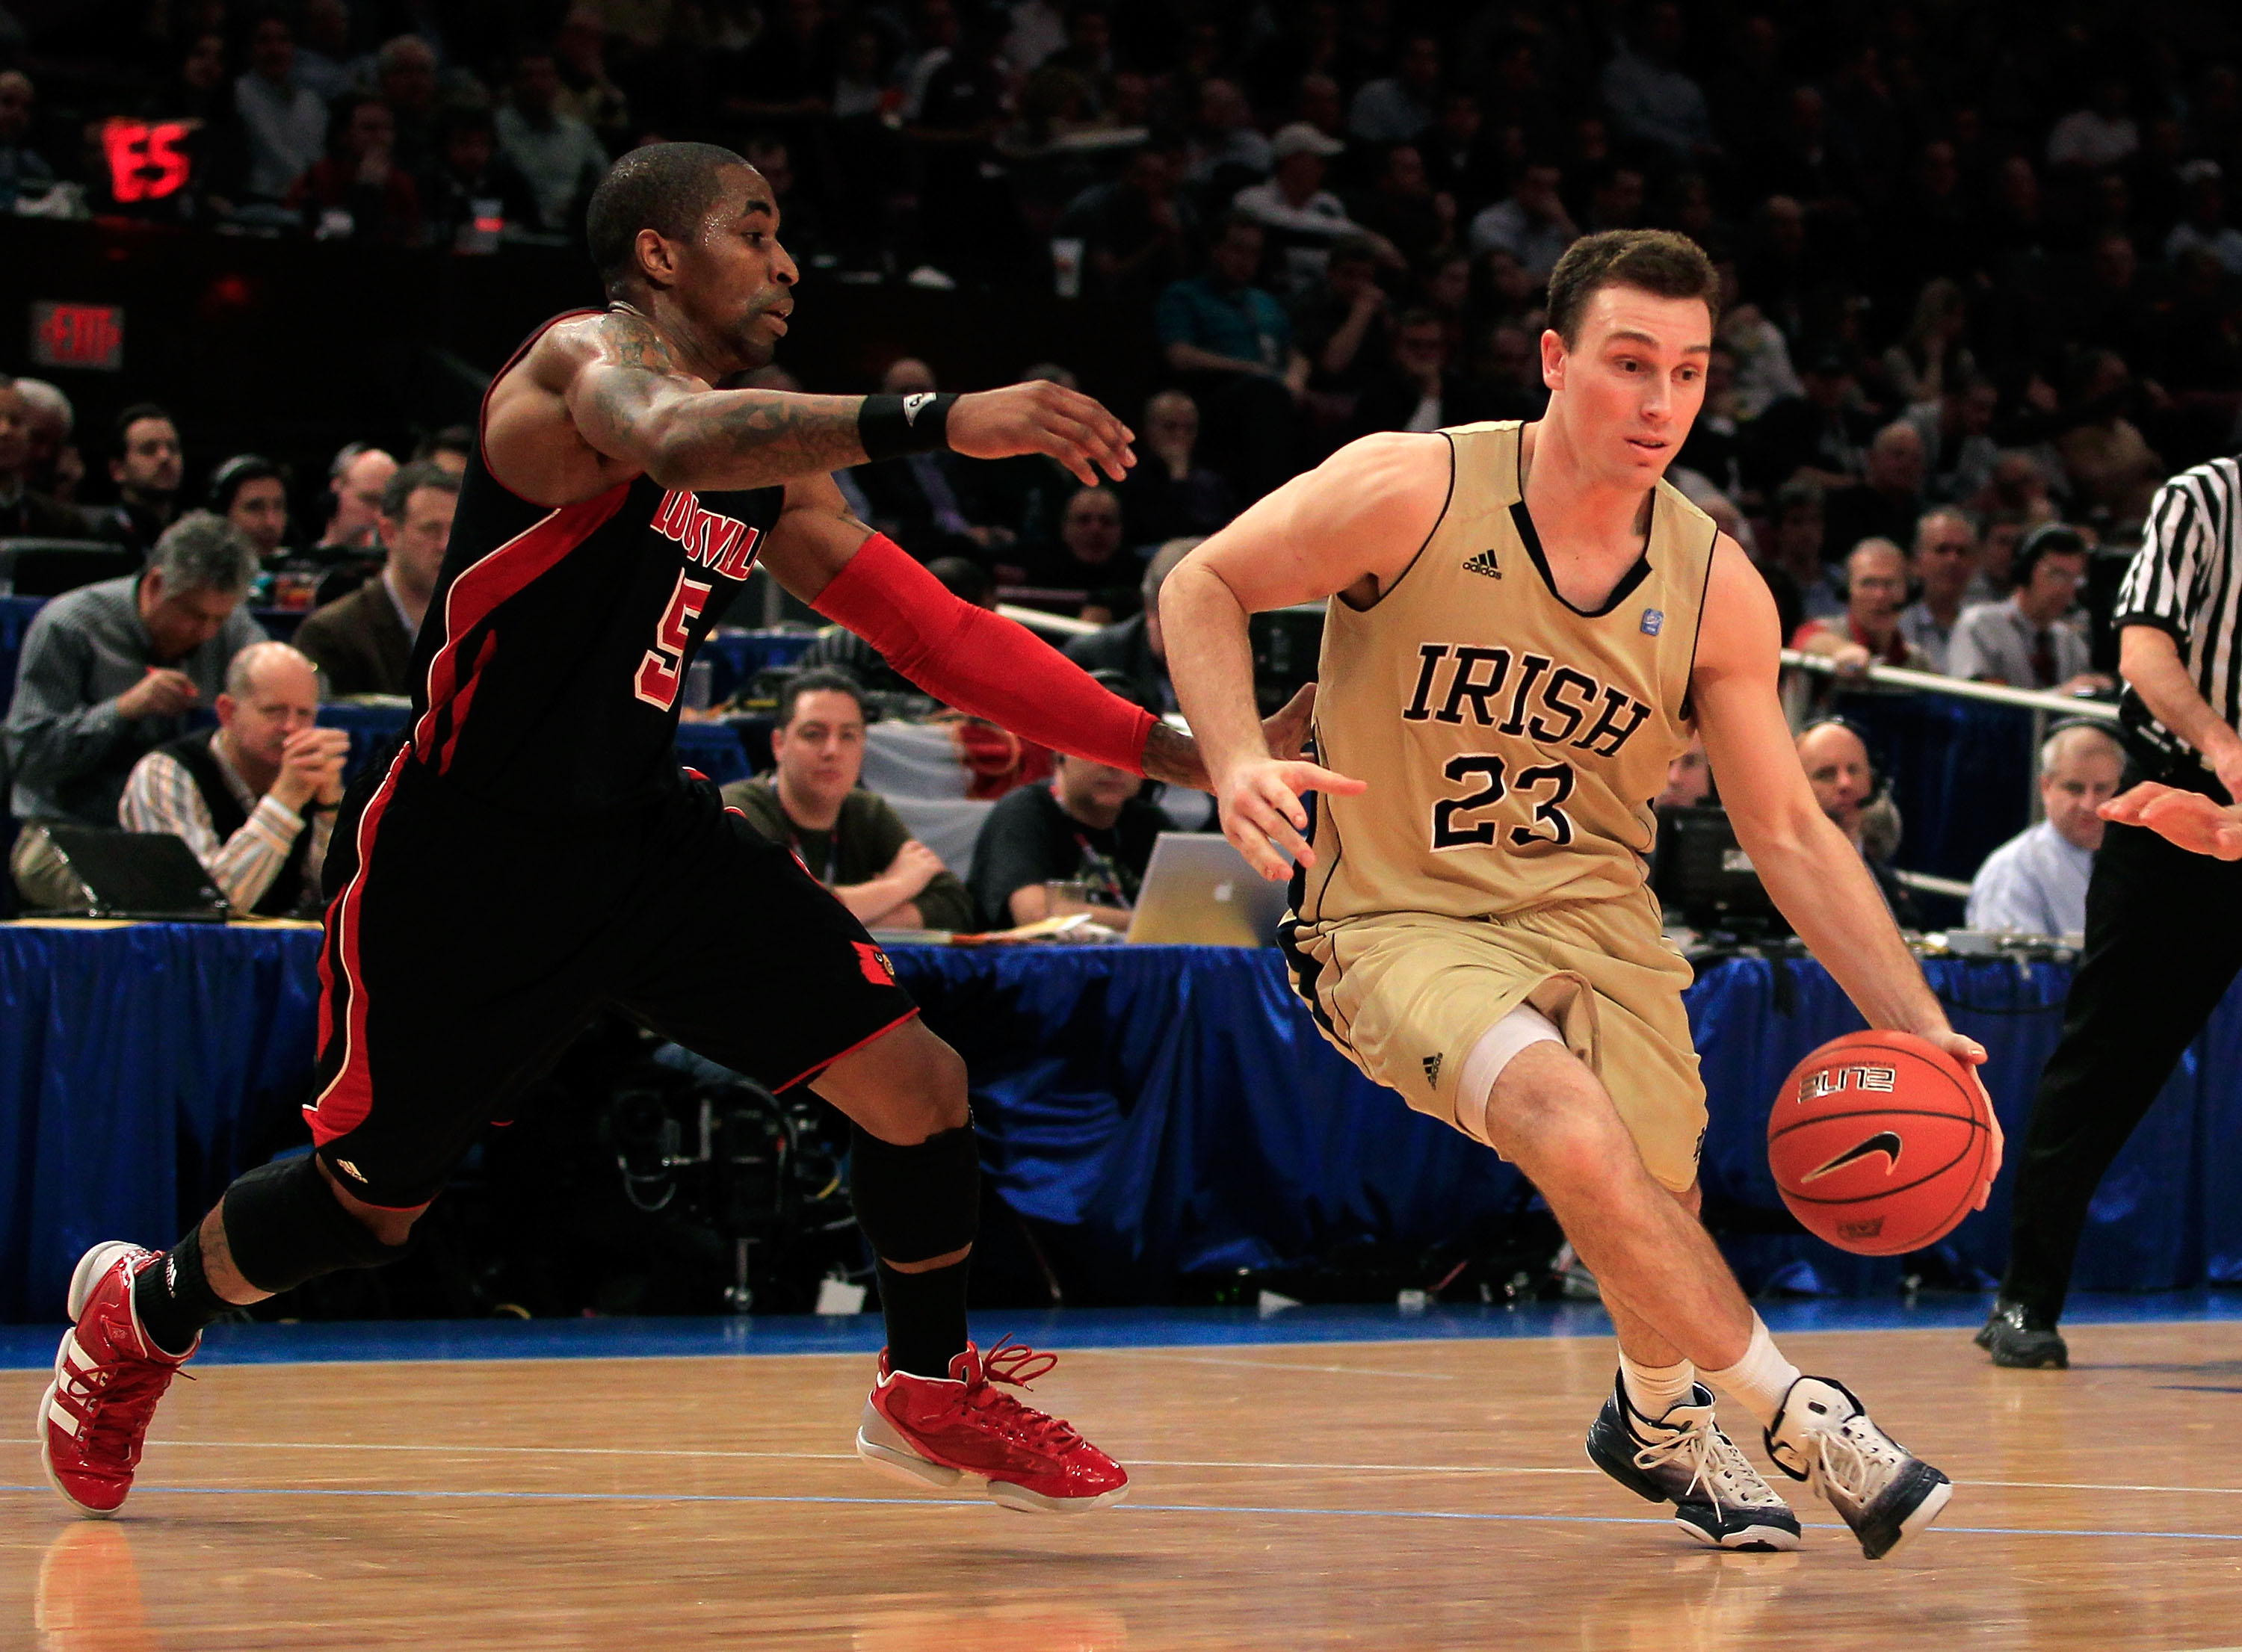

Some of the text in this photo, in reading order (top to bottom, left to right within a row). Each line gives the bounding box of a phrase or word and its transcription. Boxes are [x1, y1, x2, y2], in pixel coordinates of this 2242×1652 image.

[1462, 561, 1502, 581] adidas
[634, 566, 712, 713] 5
[1401, 642, 1653, 758] IRISH
[1430, 752, 1577, 853] 23
